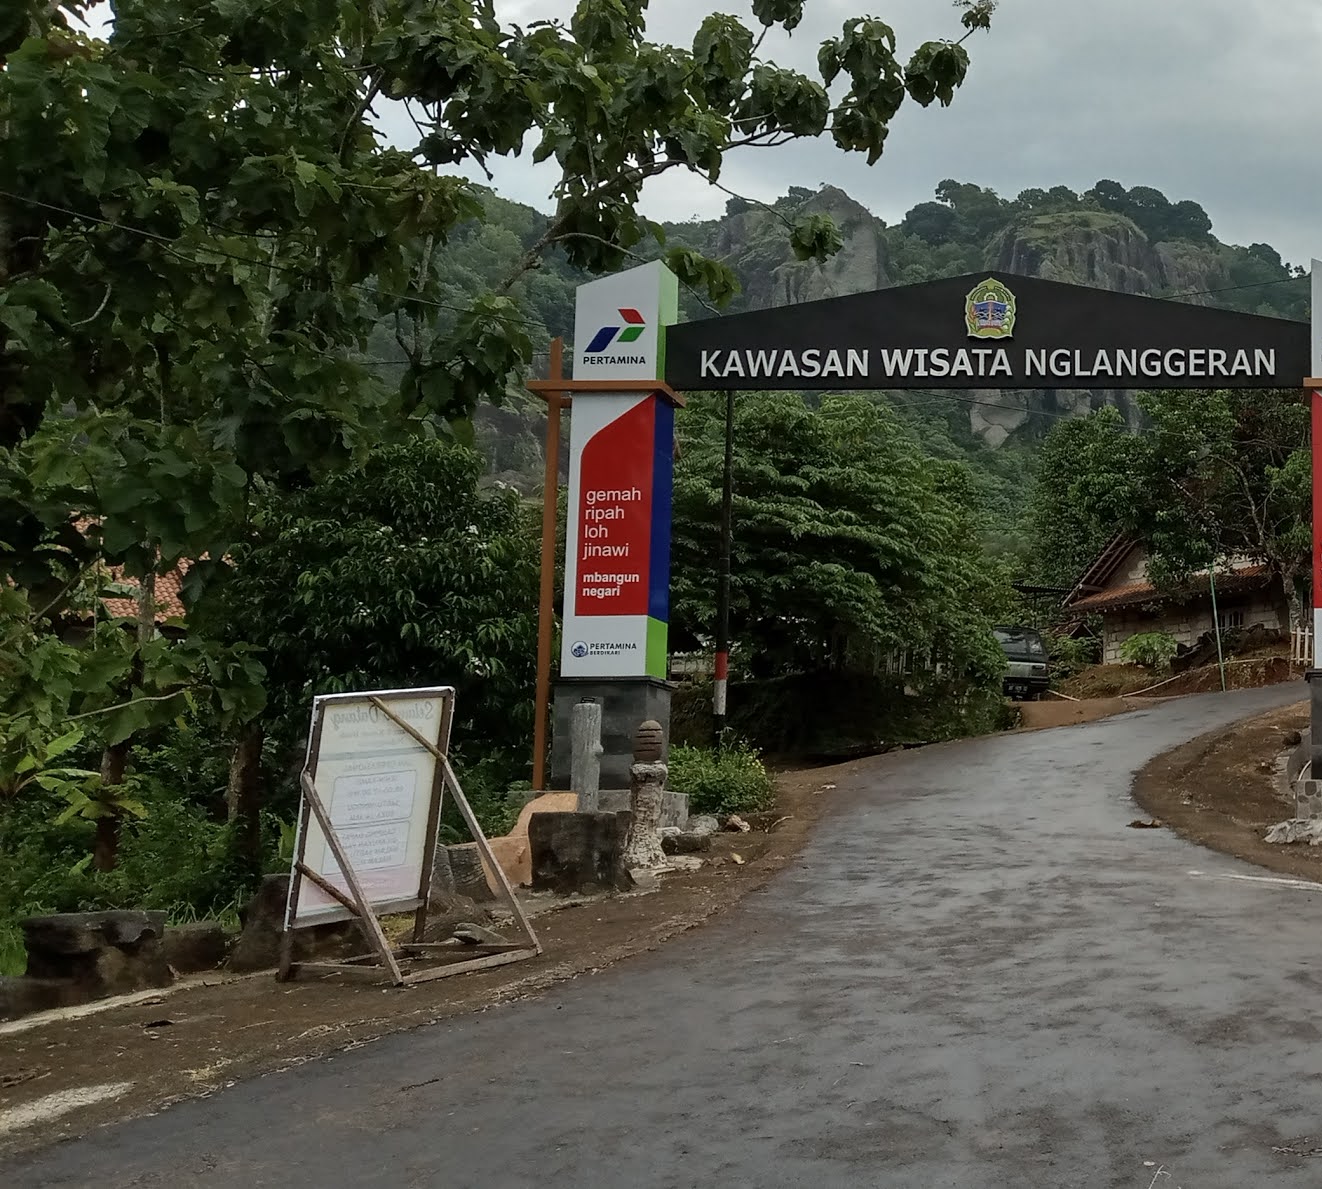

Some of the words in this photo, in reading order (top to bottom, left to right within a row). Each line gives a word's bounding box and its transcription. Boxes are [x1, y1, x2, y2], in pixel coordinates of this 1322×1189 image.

[583, 356, 646, 365] PERTAMINA
[700, 350, 869, 378] KAWASAN
[881, 350, 1013, 377] WISATA
[1025, 348, 1276, 376] NGLANGGERAN
[586, 487, 642, 505] gemah
[585, 505, 625, 523] ripah
[584, 524, 608, 538] loh
[582, 543, 629, 560] jinawi
[583, 572, 640, 585] mbangun
[582, 586, 620, 599] negari
